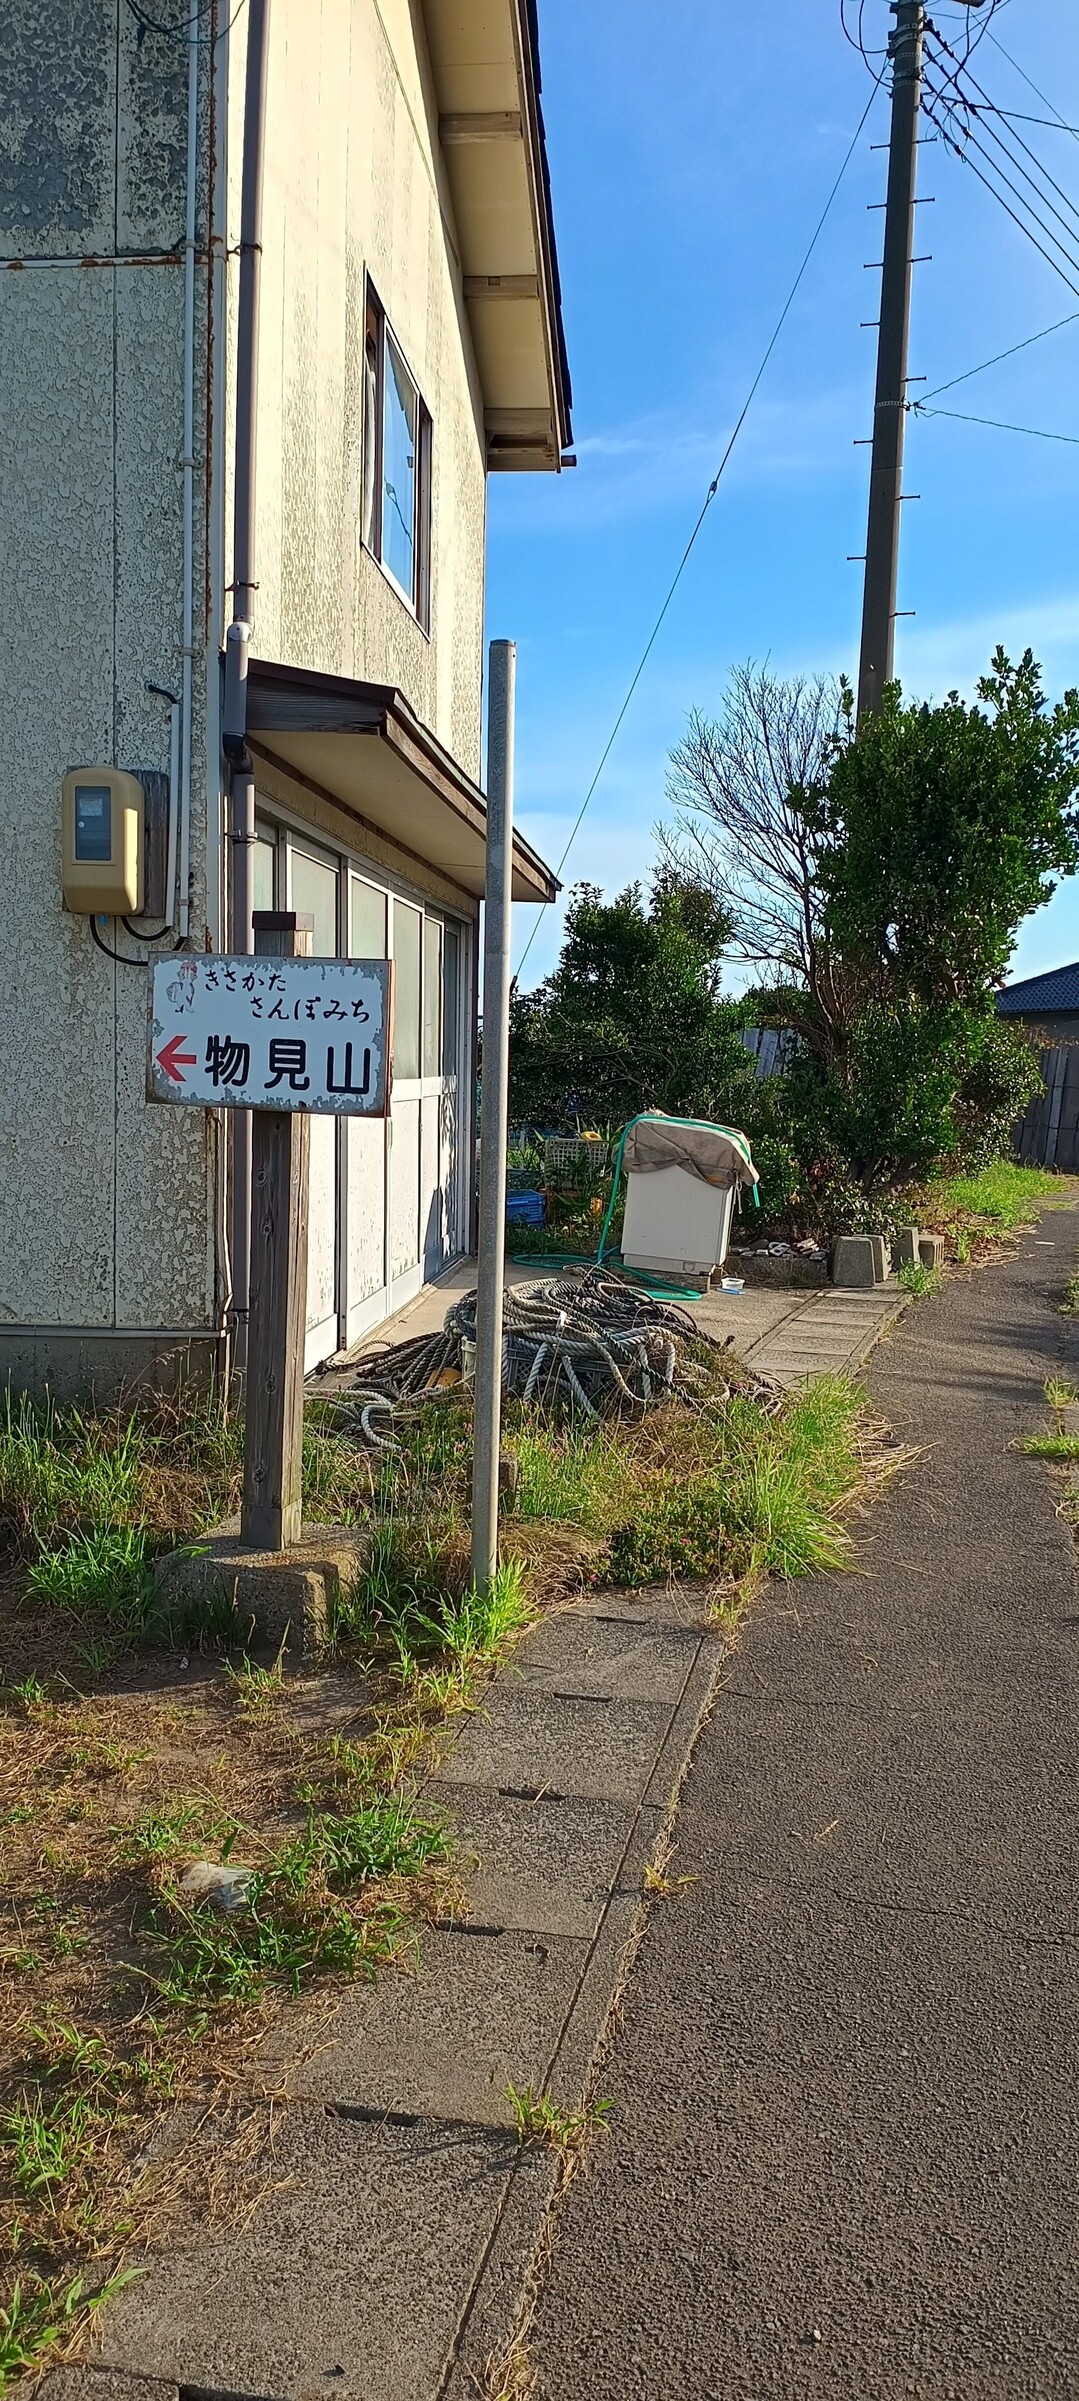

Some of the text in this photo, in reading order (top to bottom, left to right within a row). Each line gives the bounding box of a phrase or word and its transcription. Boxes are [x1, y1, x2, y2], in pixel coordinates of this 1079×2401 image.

[205, 969, 287, 992] きさかた
[250, 996, 370, 1023] さんぽみち
[205, 1034, 371, 1094] 物見山
